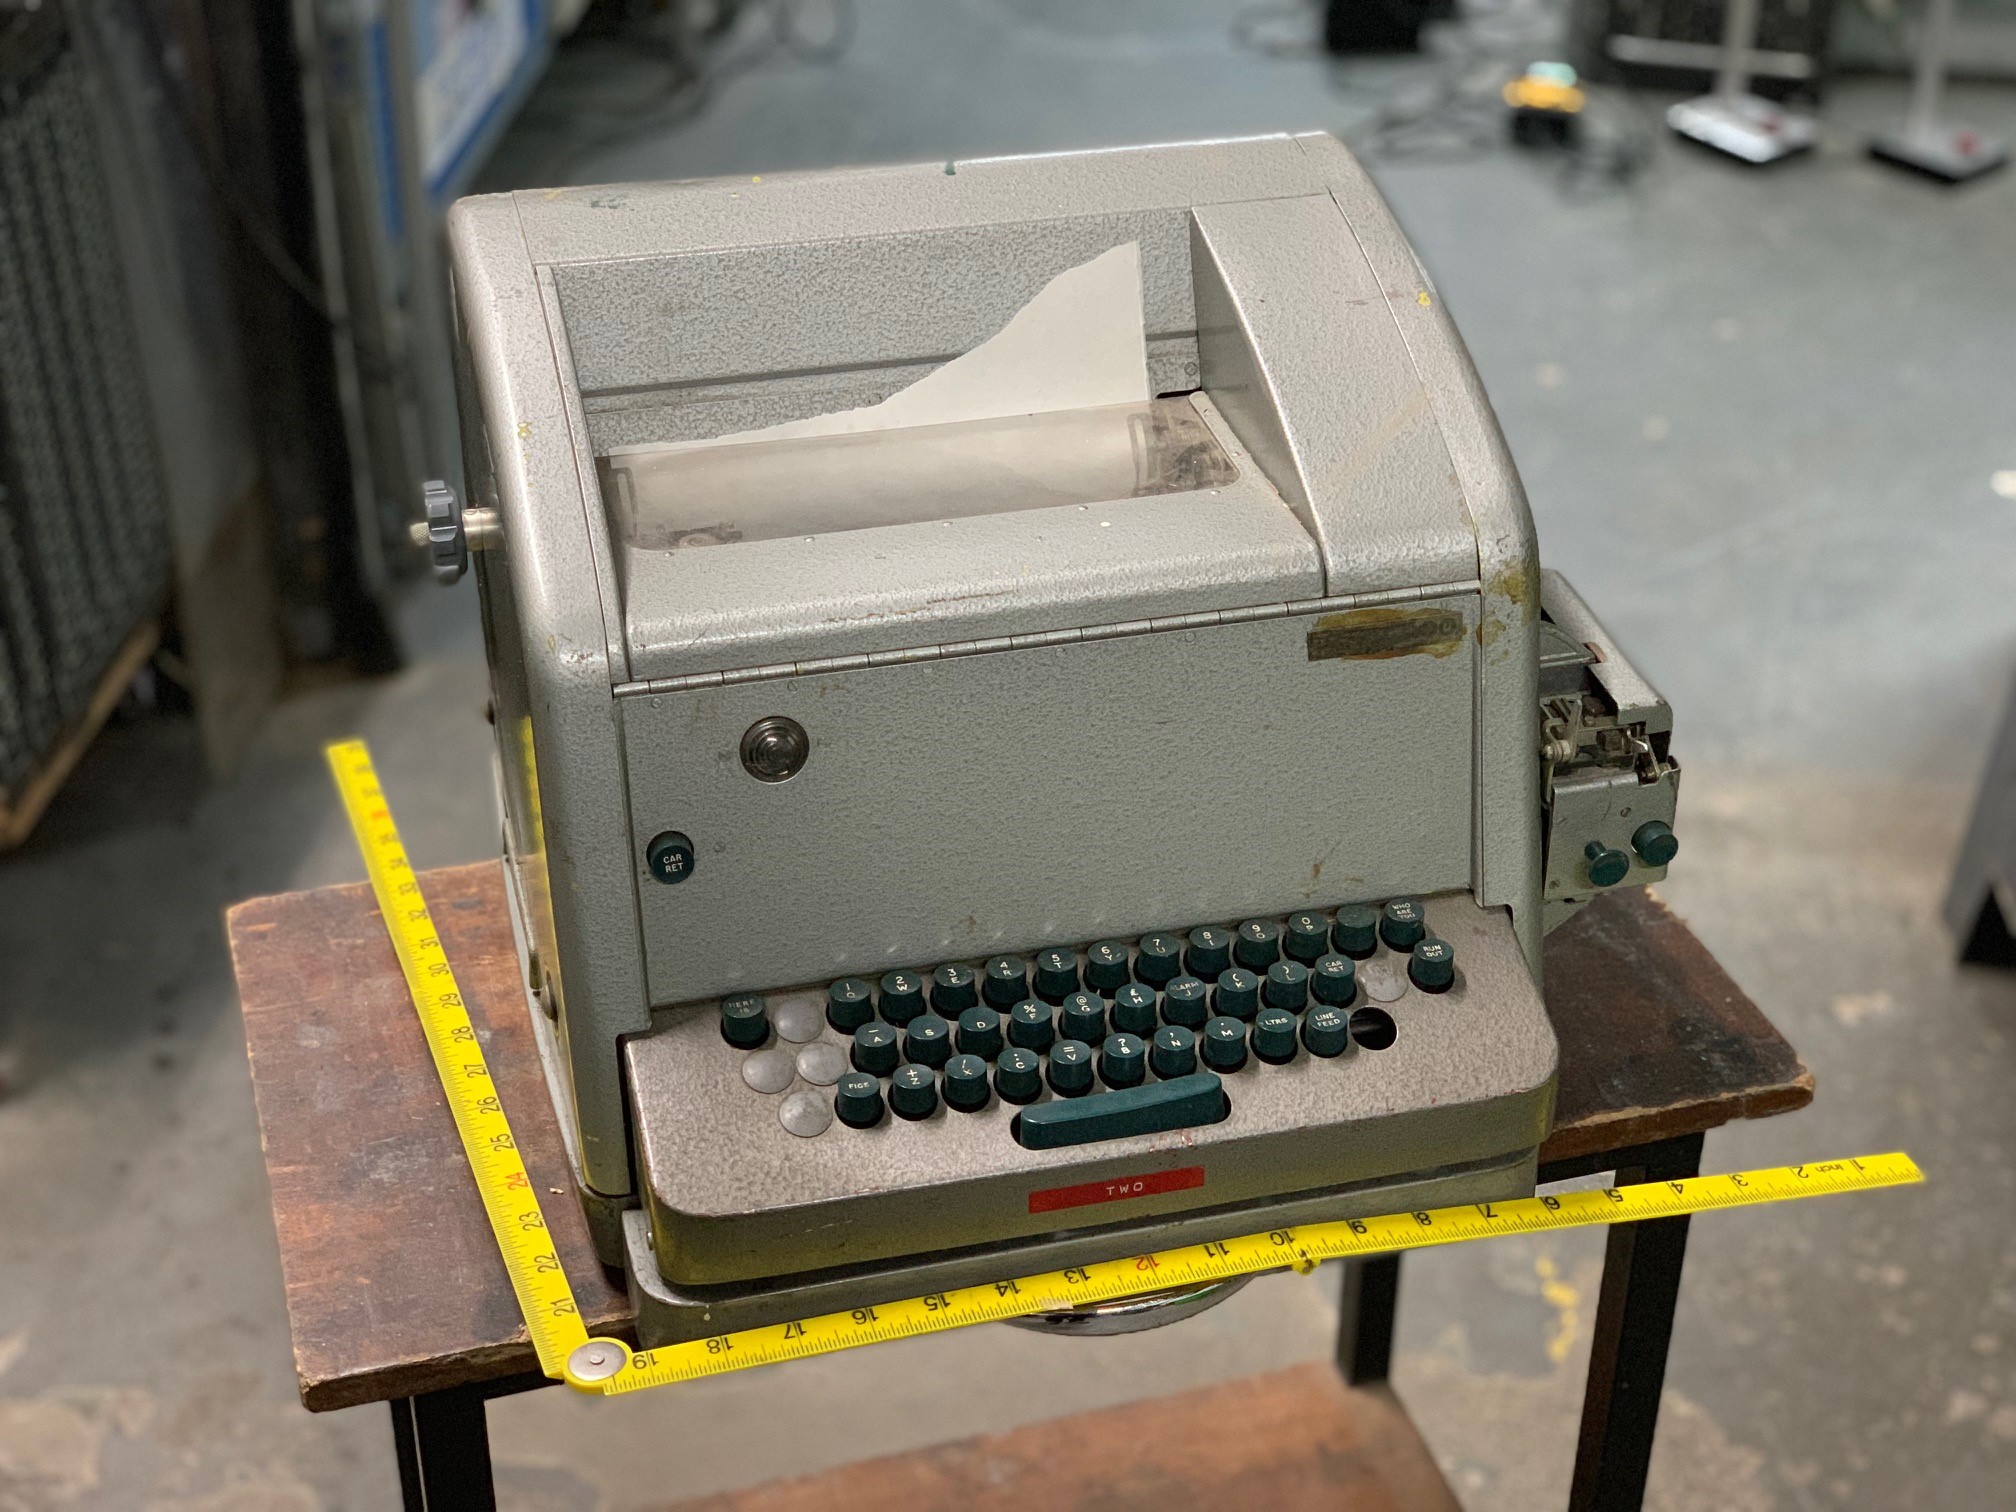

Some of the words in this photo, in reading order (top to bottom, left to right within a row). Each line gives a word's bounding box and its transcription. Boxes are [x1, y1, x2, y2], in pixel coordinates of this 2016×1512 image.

[663, 853, 683, 864] CAR
[665, 862, 684, 873] RET
[1391, 902, 1411, 910] WHO
[1251, 924, 1261, 932] 9
[1202, 931, 1212, 940] 8
[420, 937, 439, 950] 31
[1152, 938, 1160, 946] 7
[1101, 946, 1110, 954] 6
[1422, 944, 1442, 952] RUN
[1051, 954, 1060, 962] 5
[1000, 961, 1008, 969] 4
[1053, 961, 1062, 969] T
[1325, 960, 1343, 968] CAR
[1327, 965, 1344, 973] RET
[428, 963, 450, 978] 30
[947, 968, 957, 977] 3
[895, 975, 905, 984] 2
[950, 976, 961, 984] E
[1185, 989, 1192, 997] J
[438, 993, 462, 1009] 29
[1075, 995, 1087, 1006] @
[1132, 996, 1143, 1004] H
[1023, 1004, 1036, 1013] %
[1265, 1017, 1289, 1026] LTRS
[1314, 1011, 1336, 1021] LINE
[1317, 1018, 1341, 1027] FEED
[450, 1026, 474, 1043] 28
[1220, 1029, 1234, 1037] M
[1171, 1039, 1182, 1047] N
[1120, 1046, 1131, 1055] B
[1066, 1053, 1077, 1061] V
[463, 1063, 487, 1078] 27
[1015, 1061, 1026, 1069] C
[962, 1068, 973, 1076] X
[848, 1081, 870, 1090] FIGS
[910, 1077, 921, 1086] Z
[476, 1096, 500, 1114] 26
[490, 1133, 514, 1152] 25
[1794, 1166, 1810, 1178] 2
[504, 1171, 529, 1191] 24
[1732, 1174, 1748, 1187] 3
[1105, 1181, 1144, 1196] TWO
[1670, 1181, 1684, 1195] 4
[1607, 1188, 1623, 1203] 5
[1545, 1196, 1560, 1211] 6
[1485, 1204, 1498, 1218] 7
[518, 1211, 543, 1232] 23
[1416, 1211, 1432, 1226] 8
[1350, 1220, 1367, 1234] 9
[1269, 1229, 1295, 1246] 10
[1204, 1241, 1230, 1258] 11
[533, 1252, 559, 1273] 22
[1132, 1254, 1159, 1271] 12
[1063, 1266, 1091, 1284] 13
[994, 1280, 1022, 1297] 14
[553, 1297, 575, 1317] 21
[924, 1293, 951, 1311] 15
[851, 1307, 879, 1325] 16
[783, 1321, 807, 1340] 17
[706, 1336, 734, 1355] 18
[632, 1352, 659, 1370] 19
